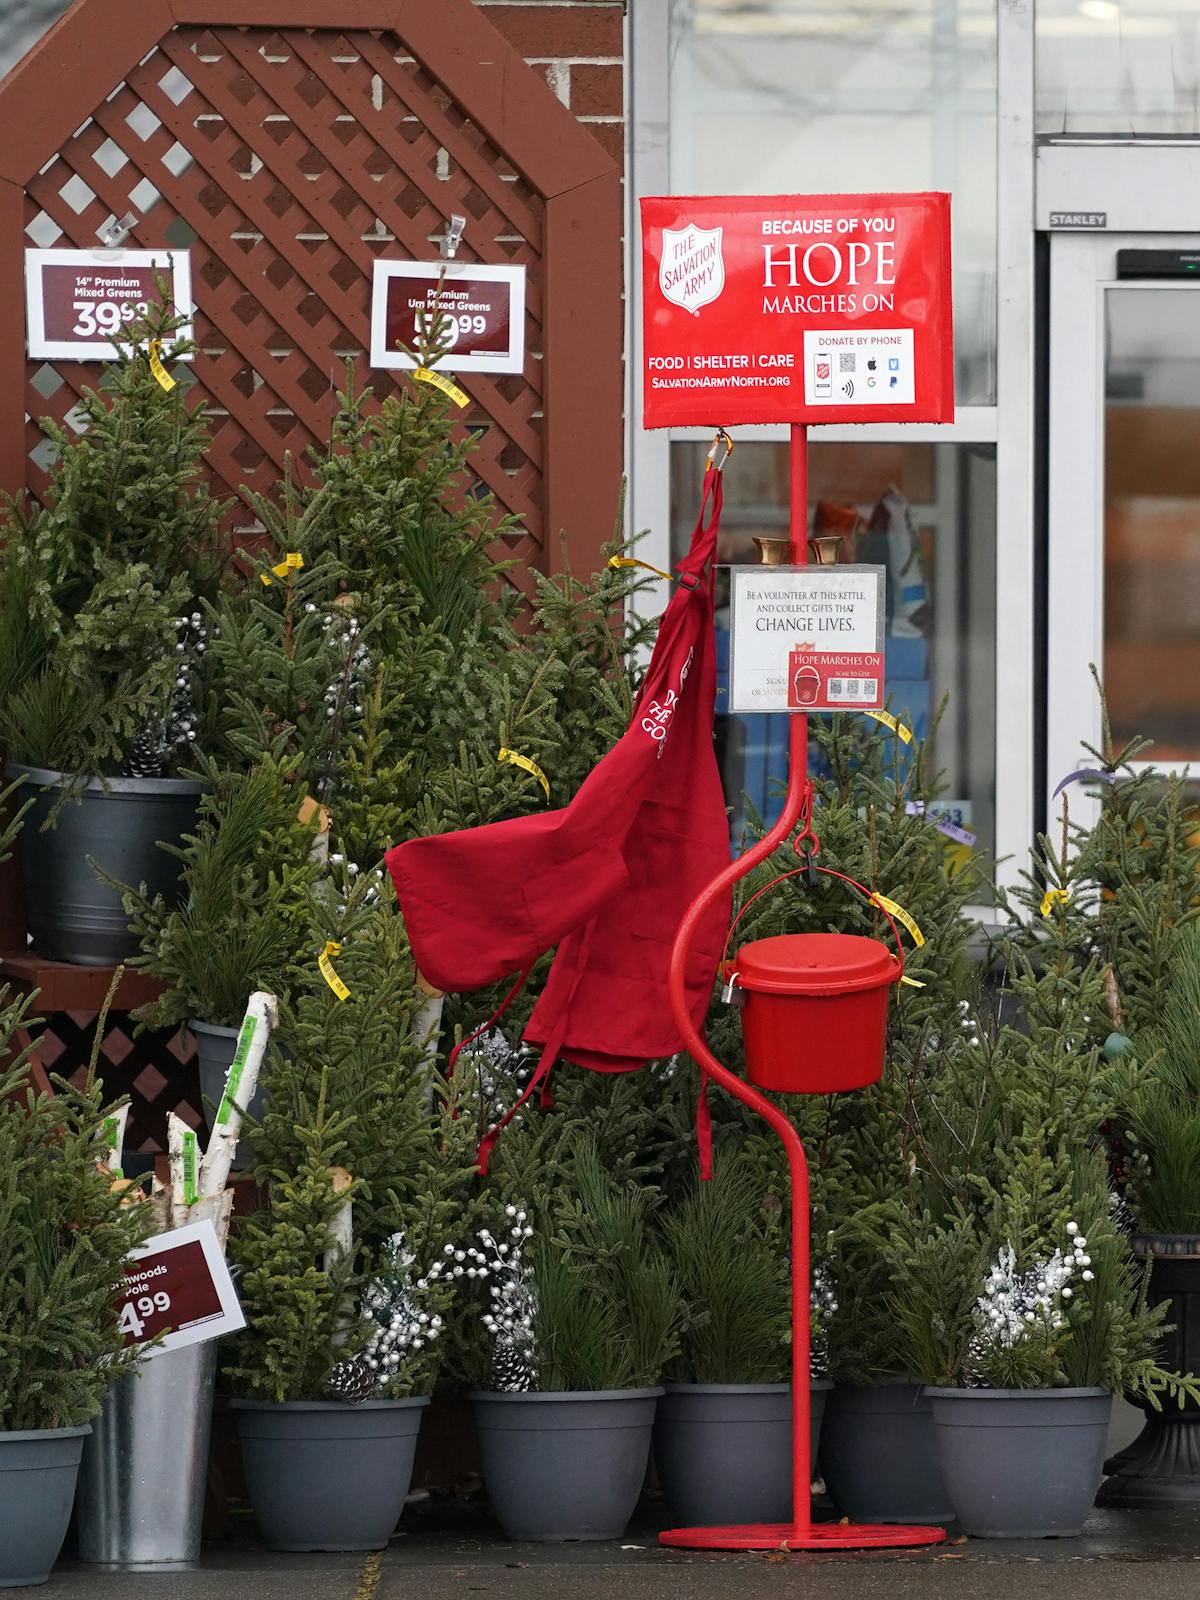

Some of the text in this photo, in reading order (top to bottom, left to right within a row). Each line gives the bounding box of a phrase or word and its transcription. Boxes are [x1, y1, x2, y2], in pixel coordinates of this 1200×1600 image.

[761, 217, 895, 235] BECAUSE OF YOU
[1050, 214, 1105, 225] STANLEY
[673, 234, 695, 260] THE
[664, 237, 717, 290] SALVATION
[761, 241, 896, 287] HOPE
[94, 277, 140, 288] Premium
[683, 261, 715, 300] ARMY
[74, 287, 143, 298] Mixed Greens
[427, 300, 454, 310] Mxed
[457, 301, 491, 312] Greens
[762, 293, 894, 314] MARCHES ON
[818, 336, 902, 346] DONATE BY PHONE
[648, 356, 685, 370] FOOD
[693, 355, 749, 369] SHELTER
[758, 354, 794, 368] CARE
[746, 590, 755, 600] BE
[757, 591, 763, 600] A
[764, 591, 807, 600] VOLUNTEER
[808, 591, 818, 600] AT
[819, 591, 837, 600] THIS
[756, 604, 854, 613] AND COLLECT GIFTS THAT
[755, 617, 855, 632] CHANGE LIVES.
[794, 654, 880, 665] HOPE MARCHES ON
